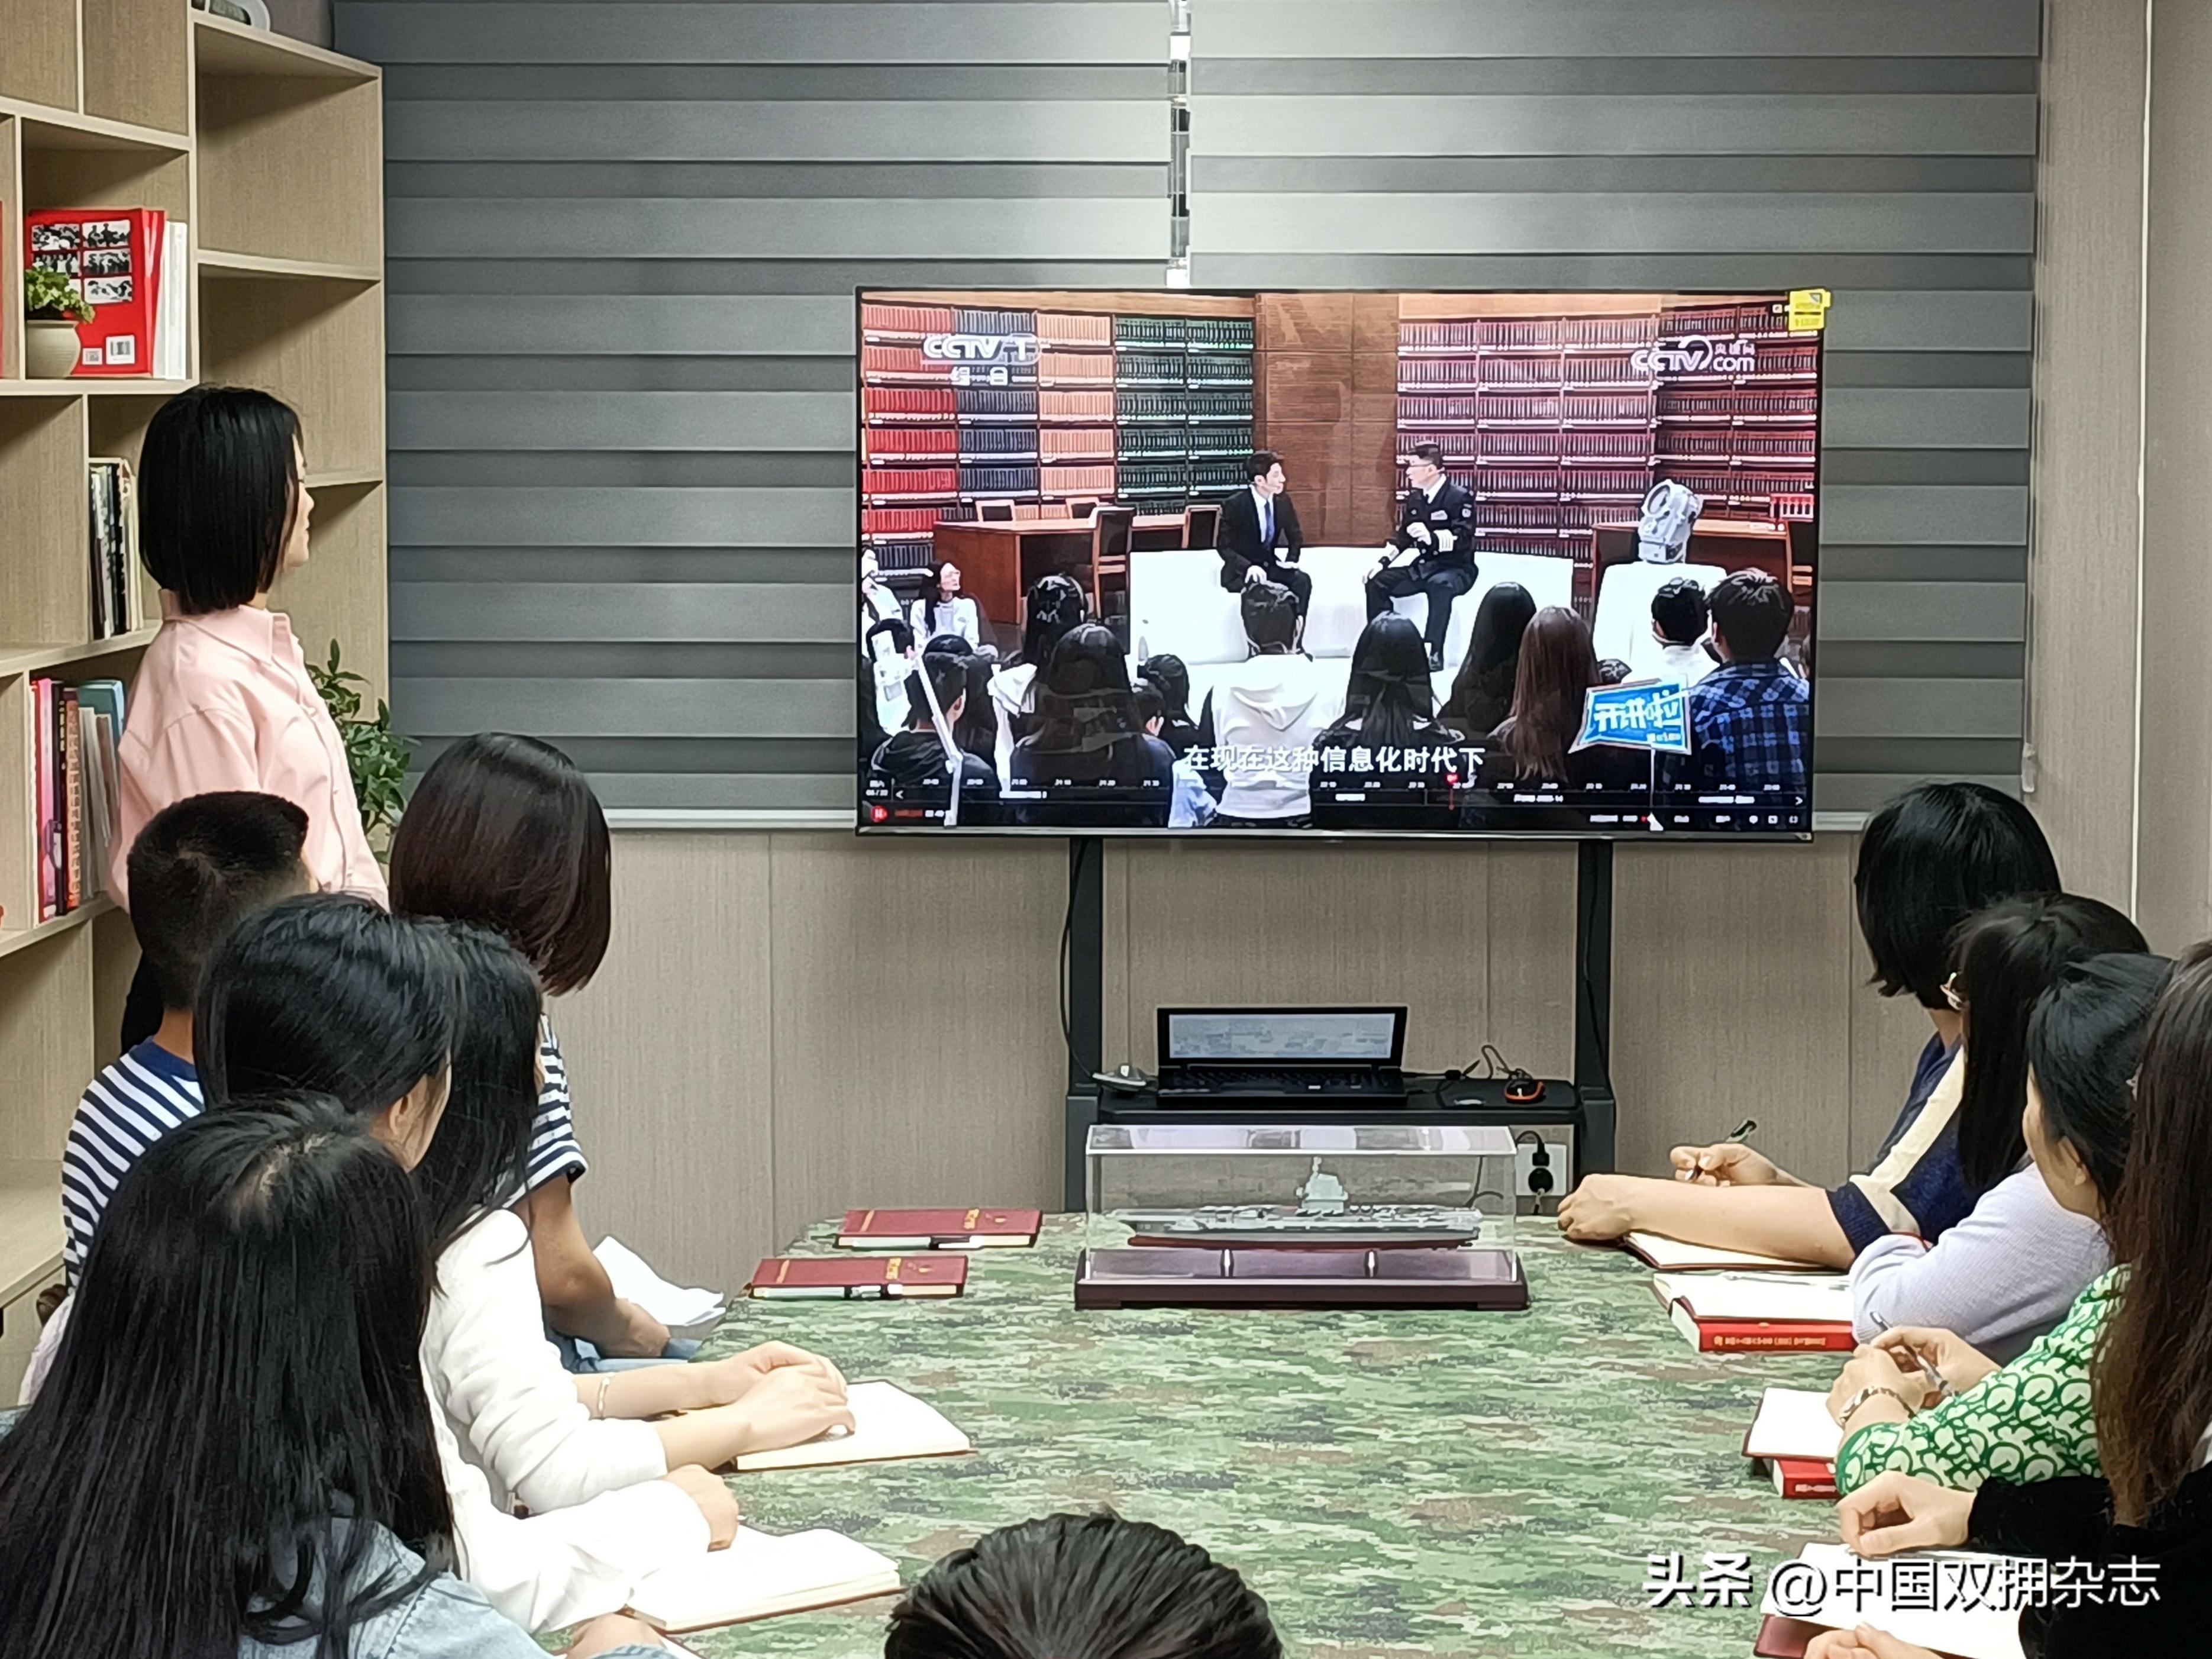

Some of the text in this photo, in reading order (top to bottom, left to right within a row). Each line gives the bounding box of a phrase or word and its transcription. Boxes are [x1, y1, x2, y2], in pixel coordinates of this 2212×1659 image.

[1713, 357, 1755, 371] com
[1183, 744, 1486, 773] 在现在这种信息化时代下
